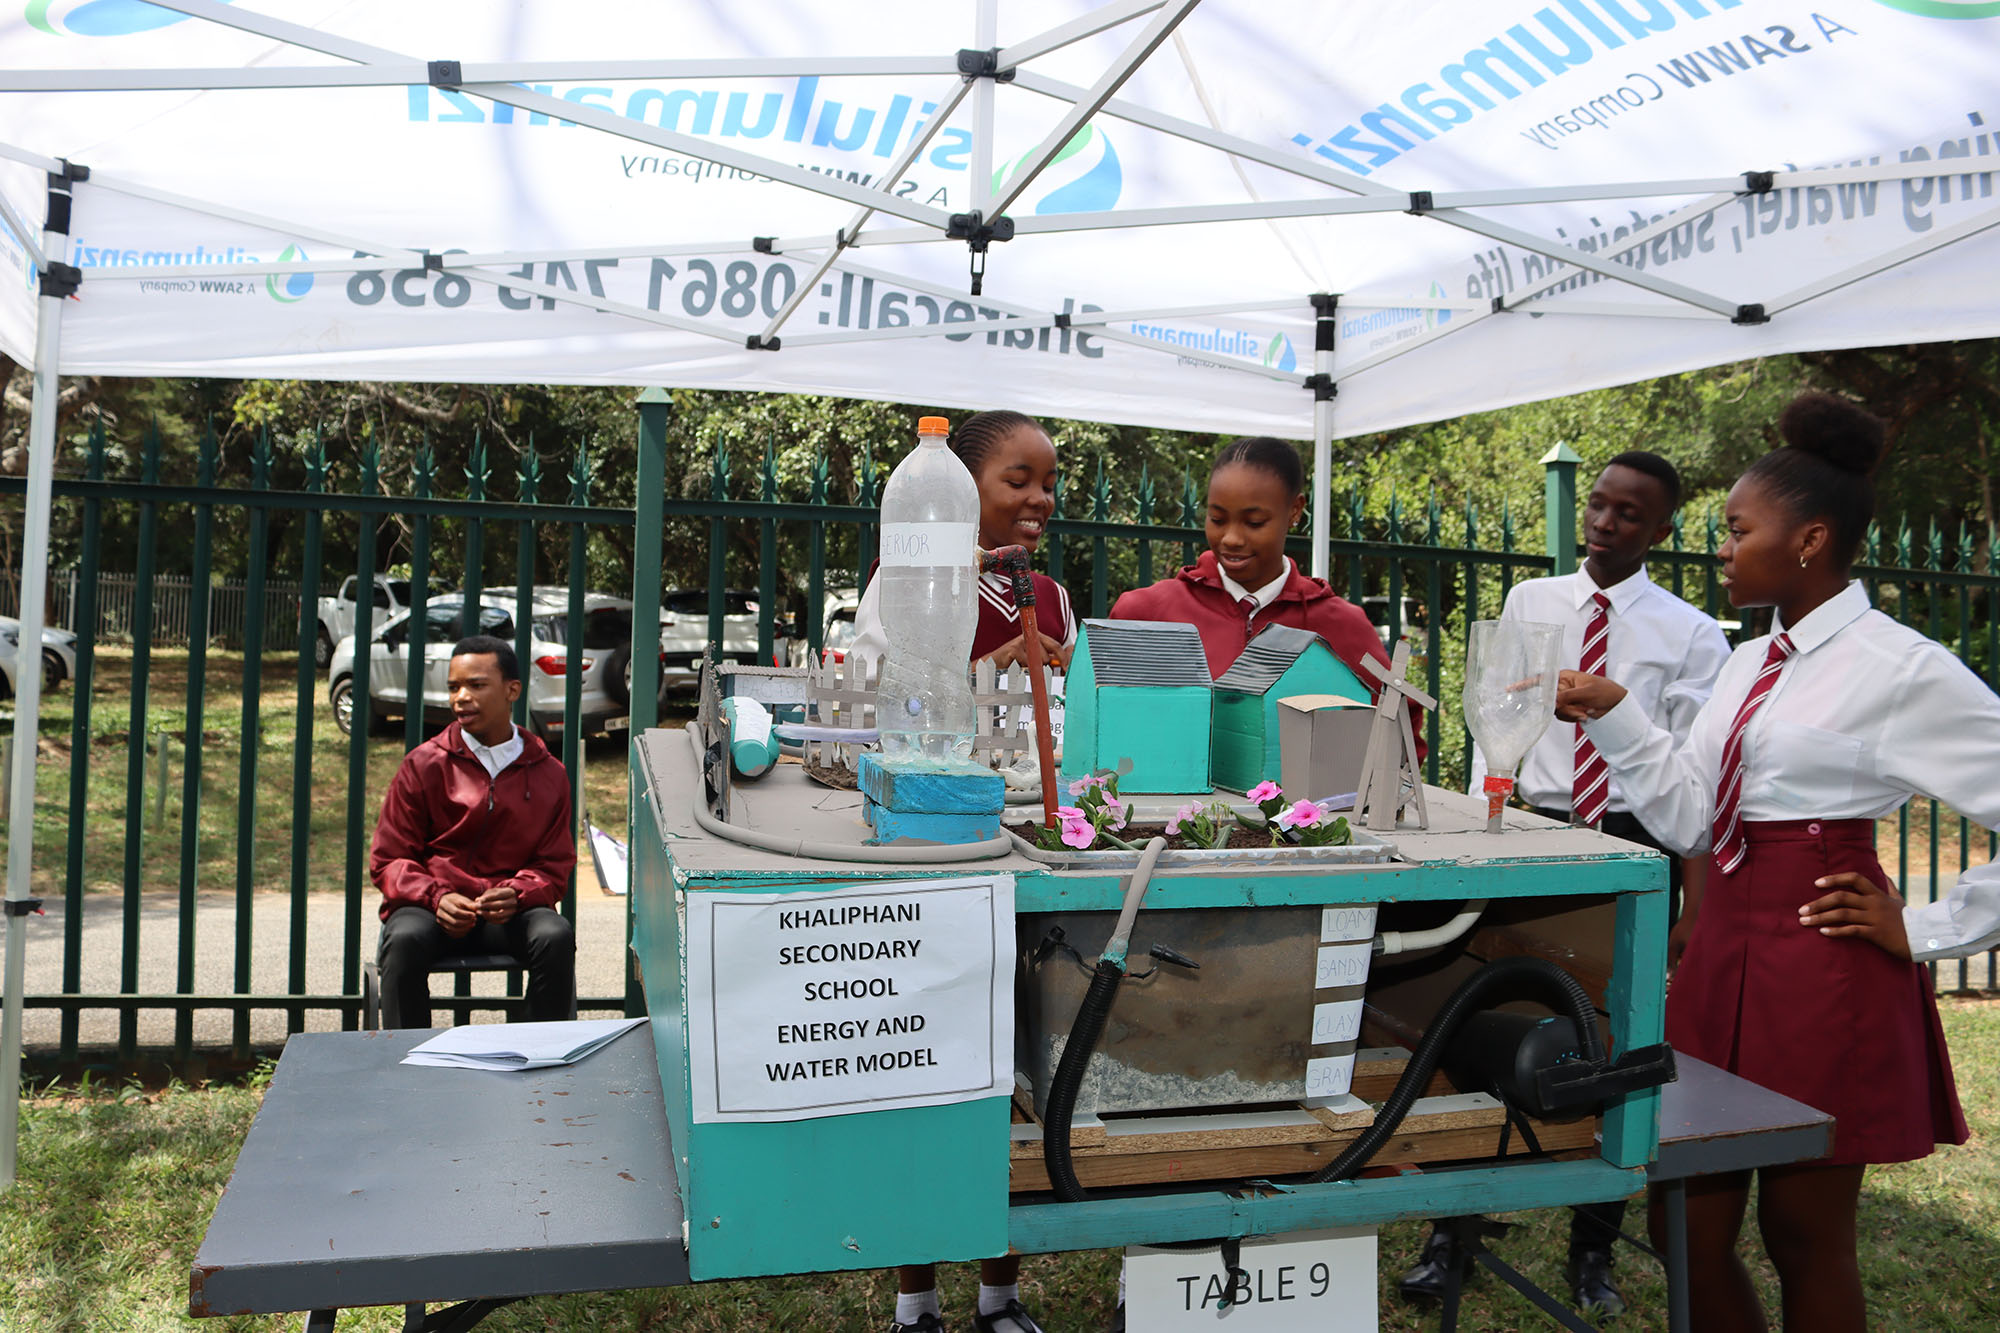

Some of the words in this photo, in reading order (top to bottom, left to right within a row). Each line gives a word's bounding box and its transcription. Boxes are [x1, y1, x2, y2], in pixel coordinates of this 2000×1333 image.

[779, 903, 921, 930] KHALIPHANI
[779, 939, 922, 965] SECONDARY
[1318, 957, 1367, 980] SANDY
[804, 977, 899, 1001] SCHOOL
[777, 1019, 869, 1044] ENERGY
[875, 1014, 926, 1036] AND
[1315, 1013, 1357, 1037] CLAY
[765, 1057, 849, 1082] WATER
[856, 1048, 938, 1074] MODEL
[1307, 1066, 1351, 1089] GRAV
[1176, 1265, 1296, 1311] TABLE
[1309, 1262, 1330, 1298] 9
